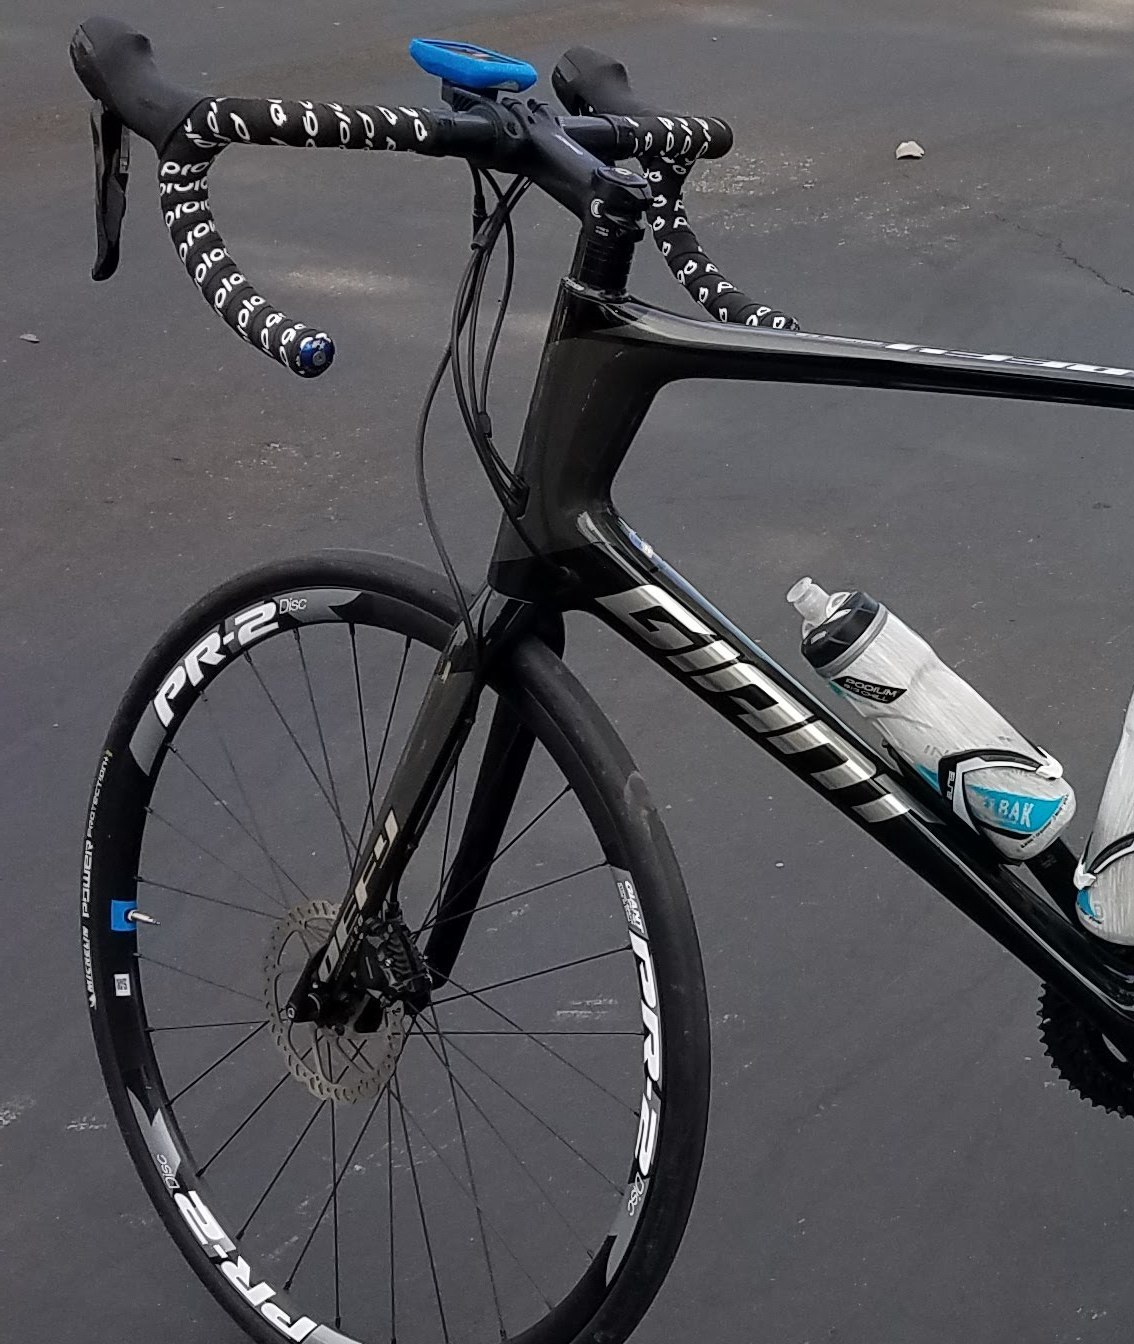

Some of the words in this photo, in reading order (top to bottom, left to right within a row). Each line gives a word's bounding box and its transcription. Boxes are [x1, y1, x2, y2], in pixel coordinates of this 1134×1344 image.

[153, 601, 279, 727] PR-2
[279, 597, 307, 614] Disc
[845, 677, 897, 697] PODIUM
[625, 880, 644, 934] GIANT
[629, 929, 660, 1177] PR-2
[157, 1154, 180, 1188] Disc
[627, 1171, 645, 1217] Disc
[174, 1190, 318, 1342] PR-2
